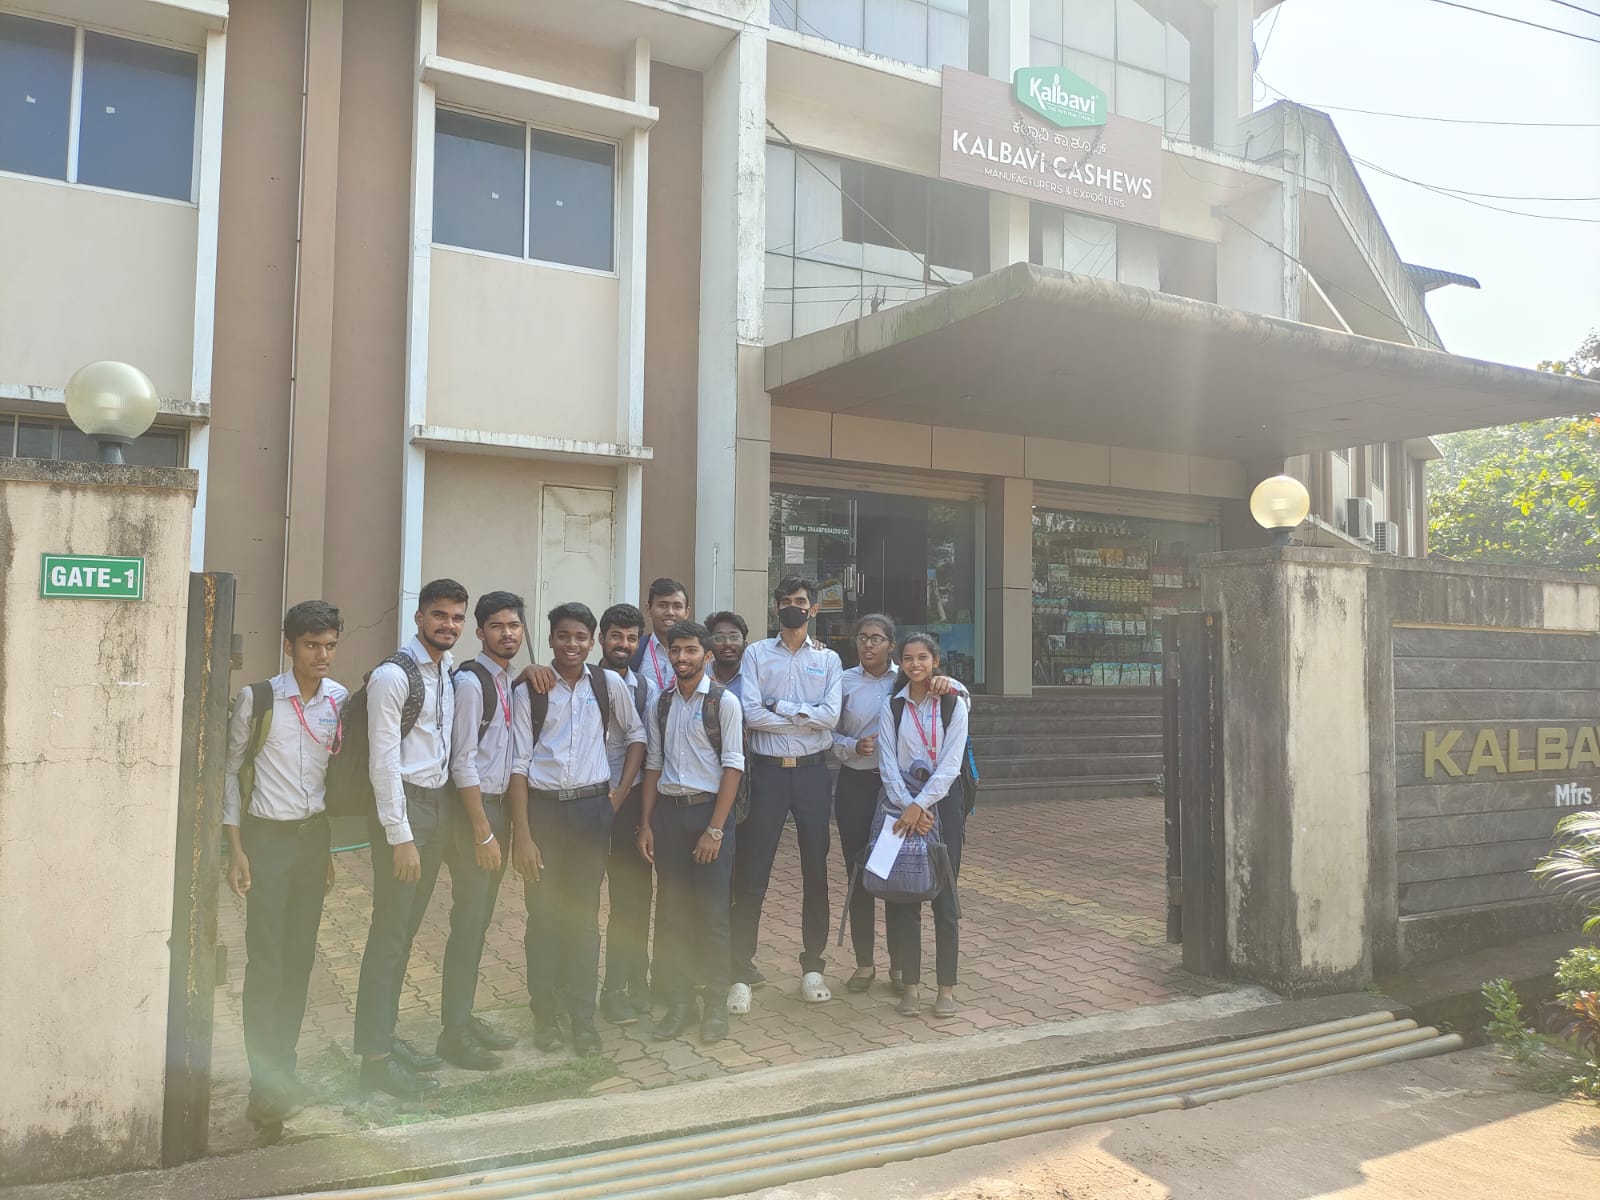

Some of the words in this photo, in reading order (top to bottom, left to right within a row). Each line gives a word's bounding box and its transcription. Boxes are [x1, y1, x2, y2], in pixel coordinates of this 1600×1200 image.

[1030, 74, 1096, 115] Kalbavi
[984, 167, 1063, 194] MANUFACTURERS
[1064, 185, 1072, 195] &
[1073, 188, 1125, 209] EXPORTERS
[1053, 156, 1153, 200] CASHEWS
[51, 565, 135, 589] GATE-1
[1424, 726, 1600, 778] KALBA
[1555, 782, 1593, 807] Mfrs
